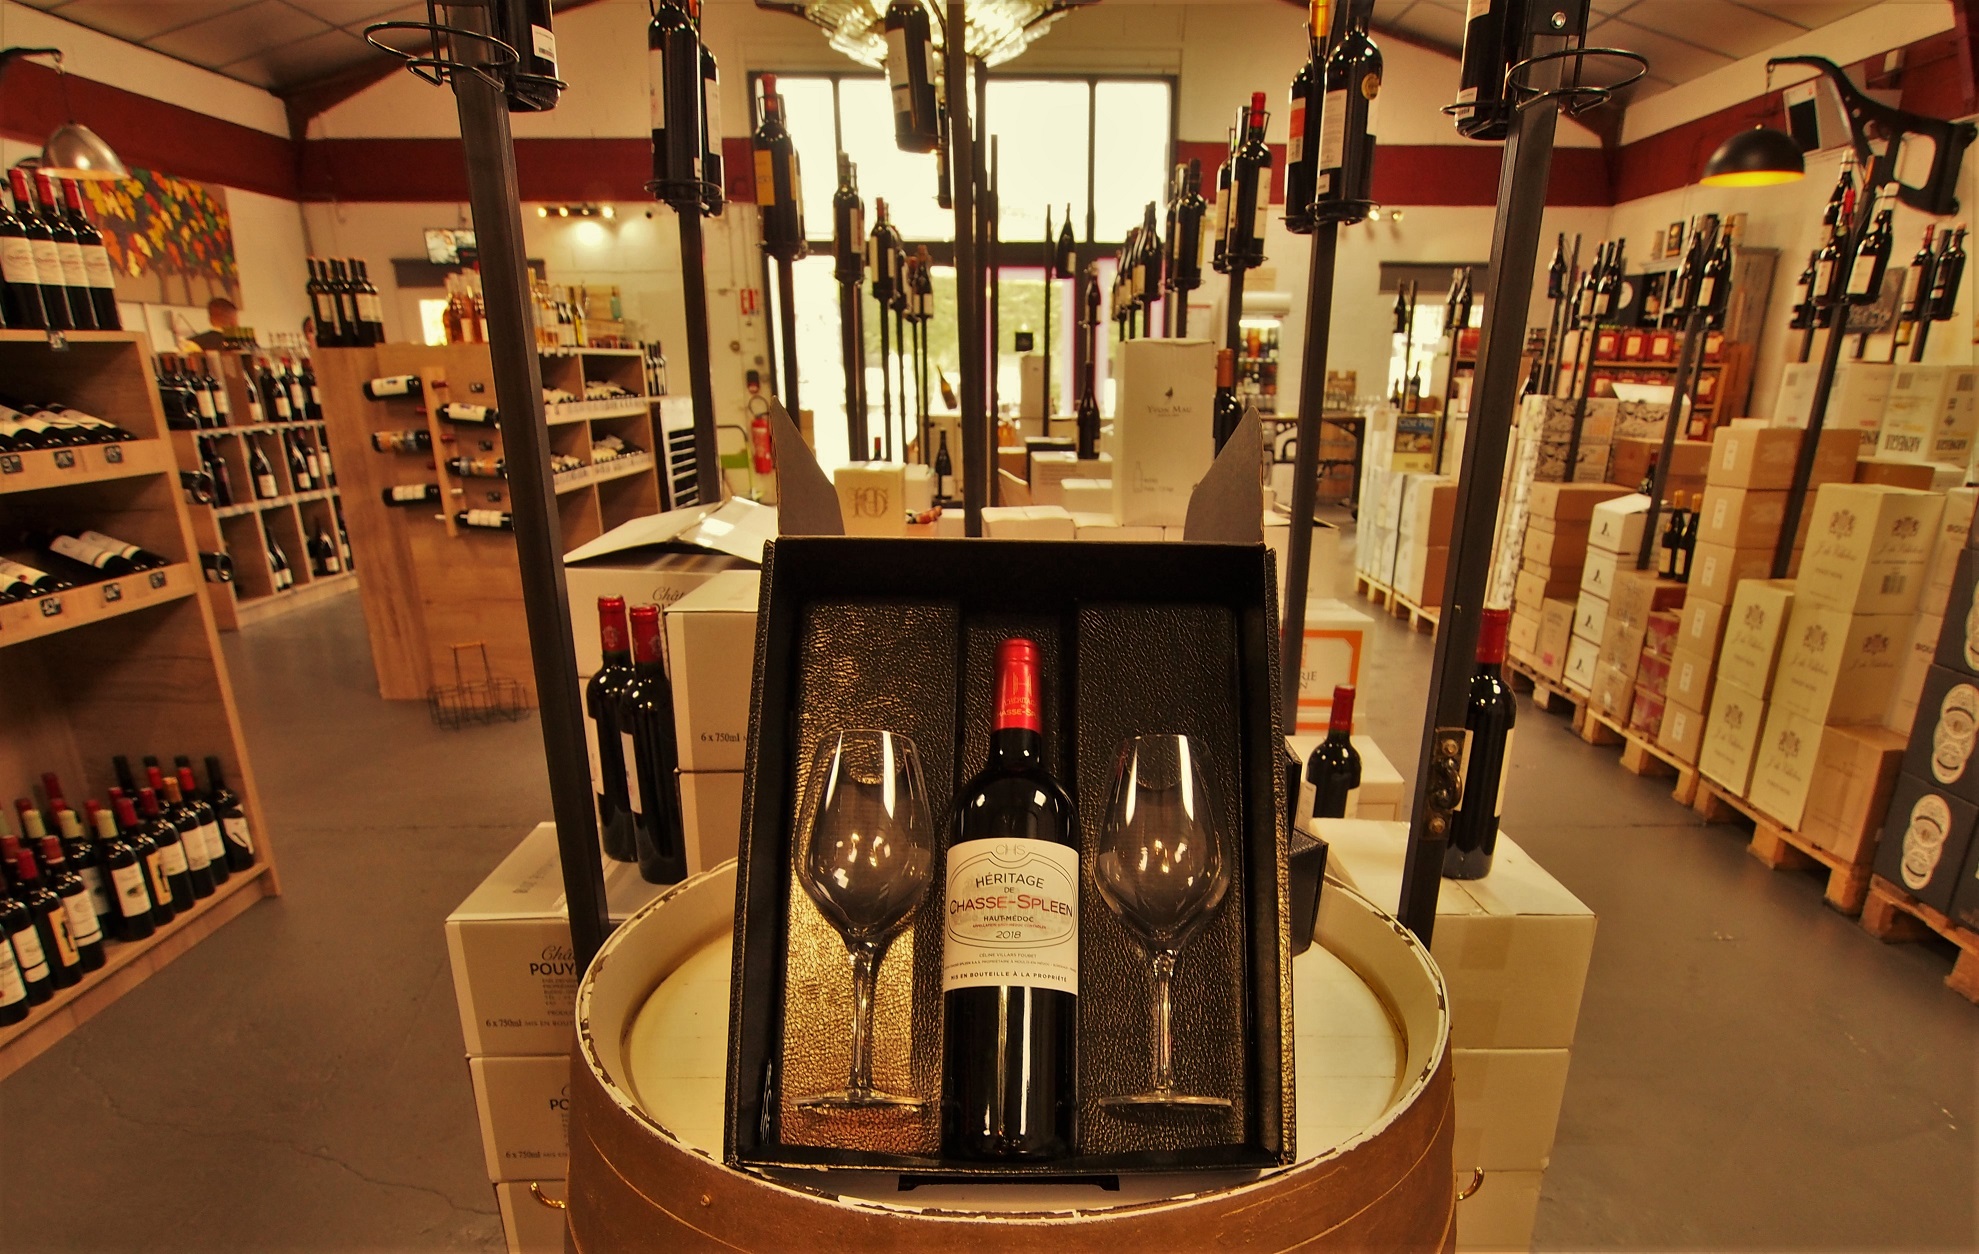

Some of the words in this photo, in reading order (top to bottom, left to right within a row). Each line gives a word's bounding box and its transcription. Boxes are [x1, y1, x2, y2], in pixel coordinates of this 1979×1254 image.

[700, 733, 707, 742] 6
[715, 733, 740, 742] 750ml
[975, 872, 1045, 890] HÉRITAGE
[949, 894, 1073, 918] CHASSE-SPLEEN
[983, 914, 1034, 923] HAUT-MÉDOC
[995, 930, 1022, 939] 2018
[529, 962, 575, 976] POUY
[969, 970, 1010, 978] BOUTEILLE
[1033, 972, 1067, 982] PROPRIÉTÉ
[486, 1019, 492, 1027] 6
